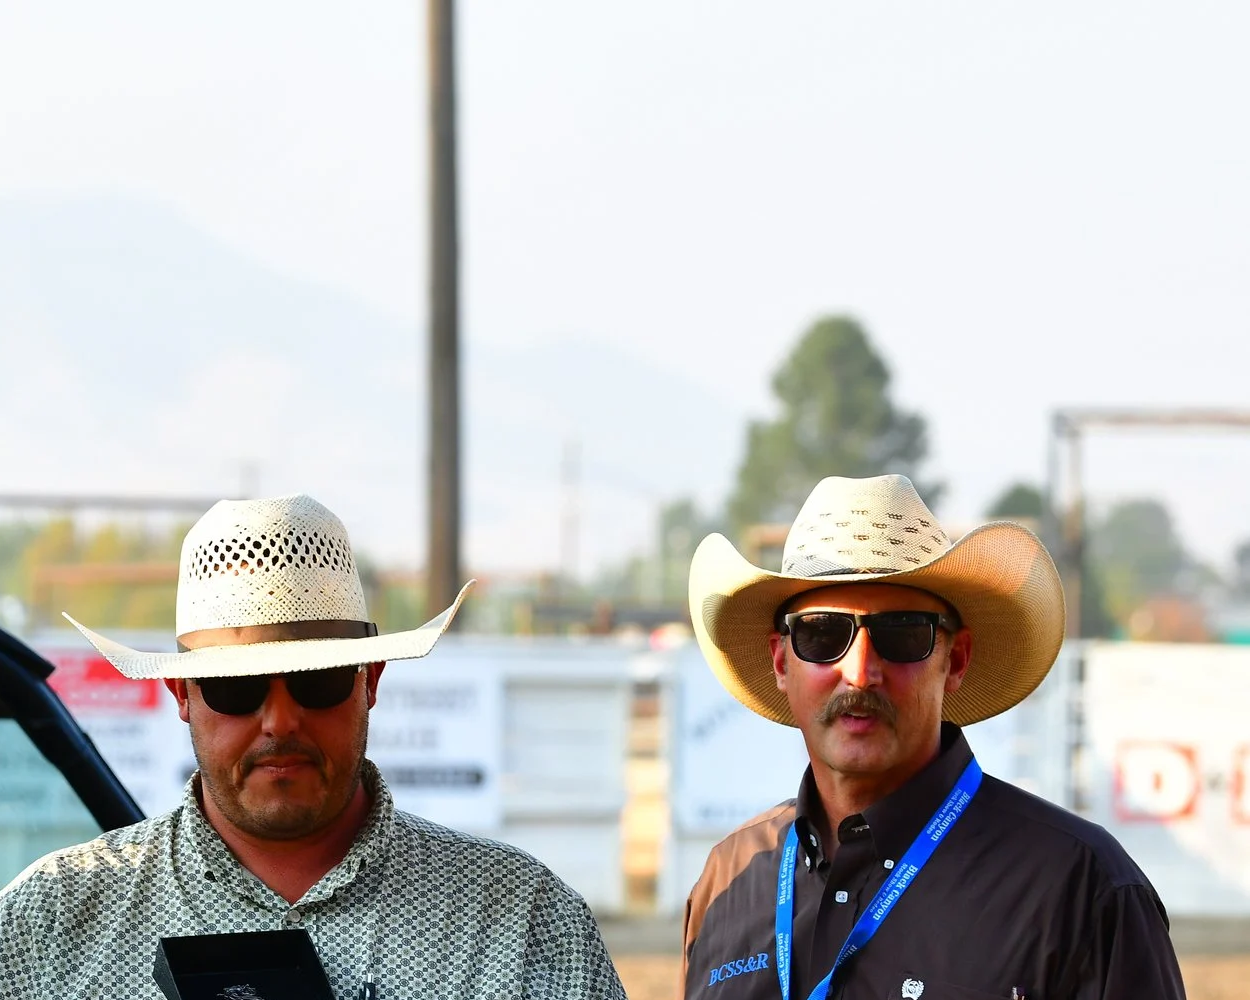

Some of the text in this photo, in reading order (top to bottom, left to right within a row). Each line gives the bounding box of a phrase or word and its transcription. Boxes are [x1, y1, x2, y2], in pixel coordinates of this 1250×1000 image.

[926, 817, 941, 835] Rodeo
[931, 791, 970, 841] Black Canyon
[779, 846, 791, 905] Black Canyon
[873, 864, 918, 920] Black Canyon
[708, 953, 769, 987] BCSS&R
